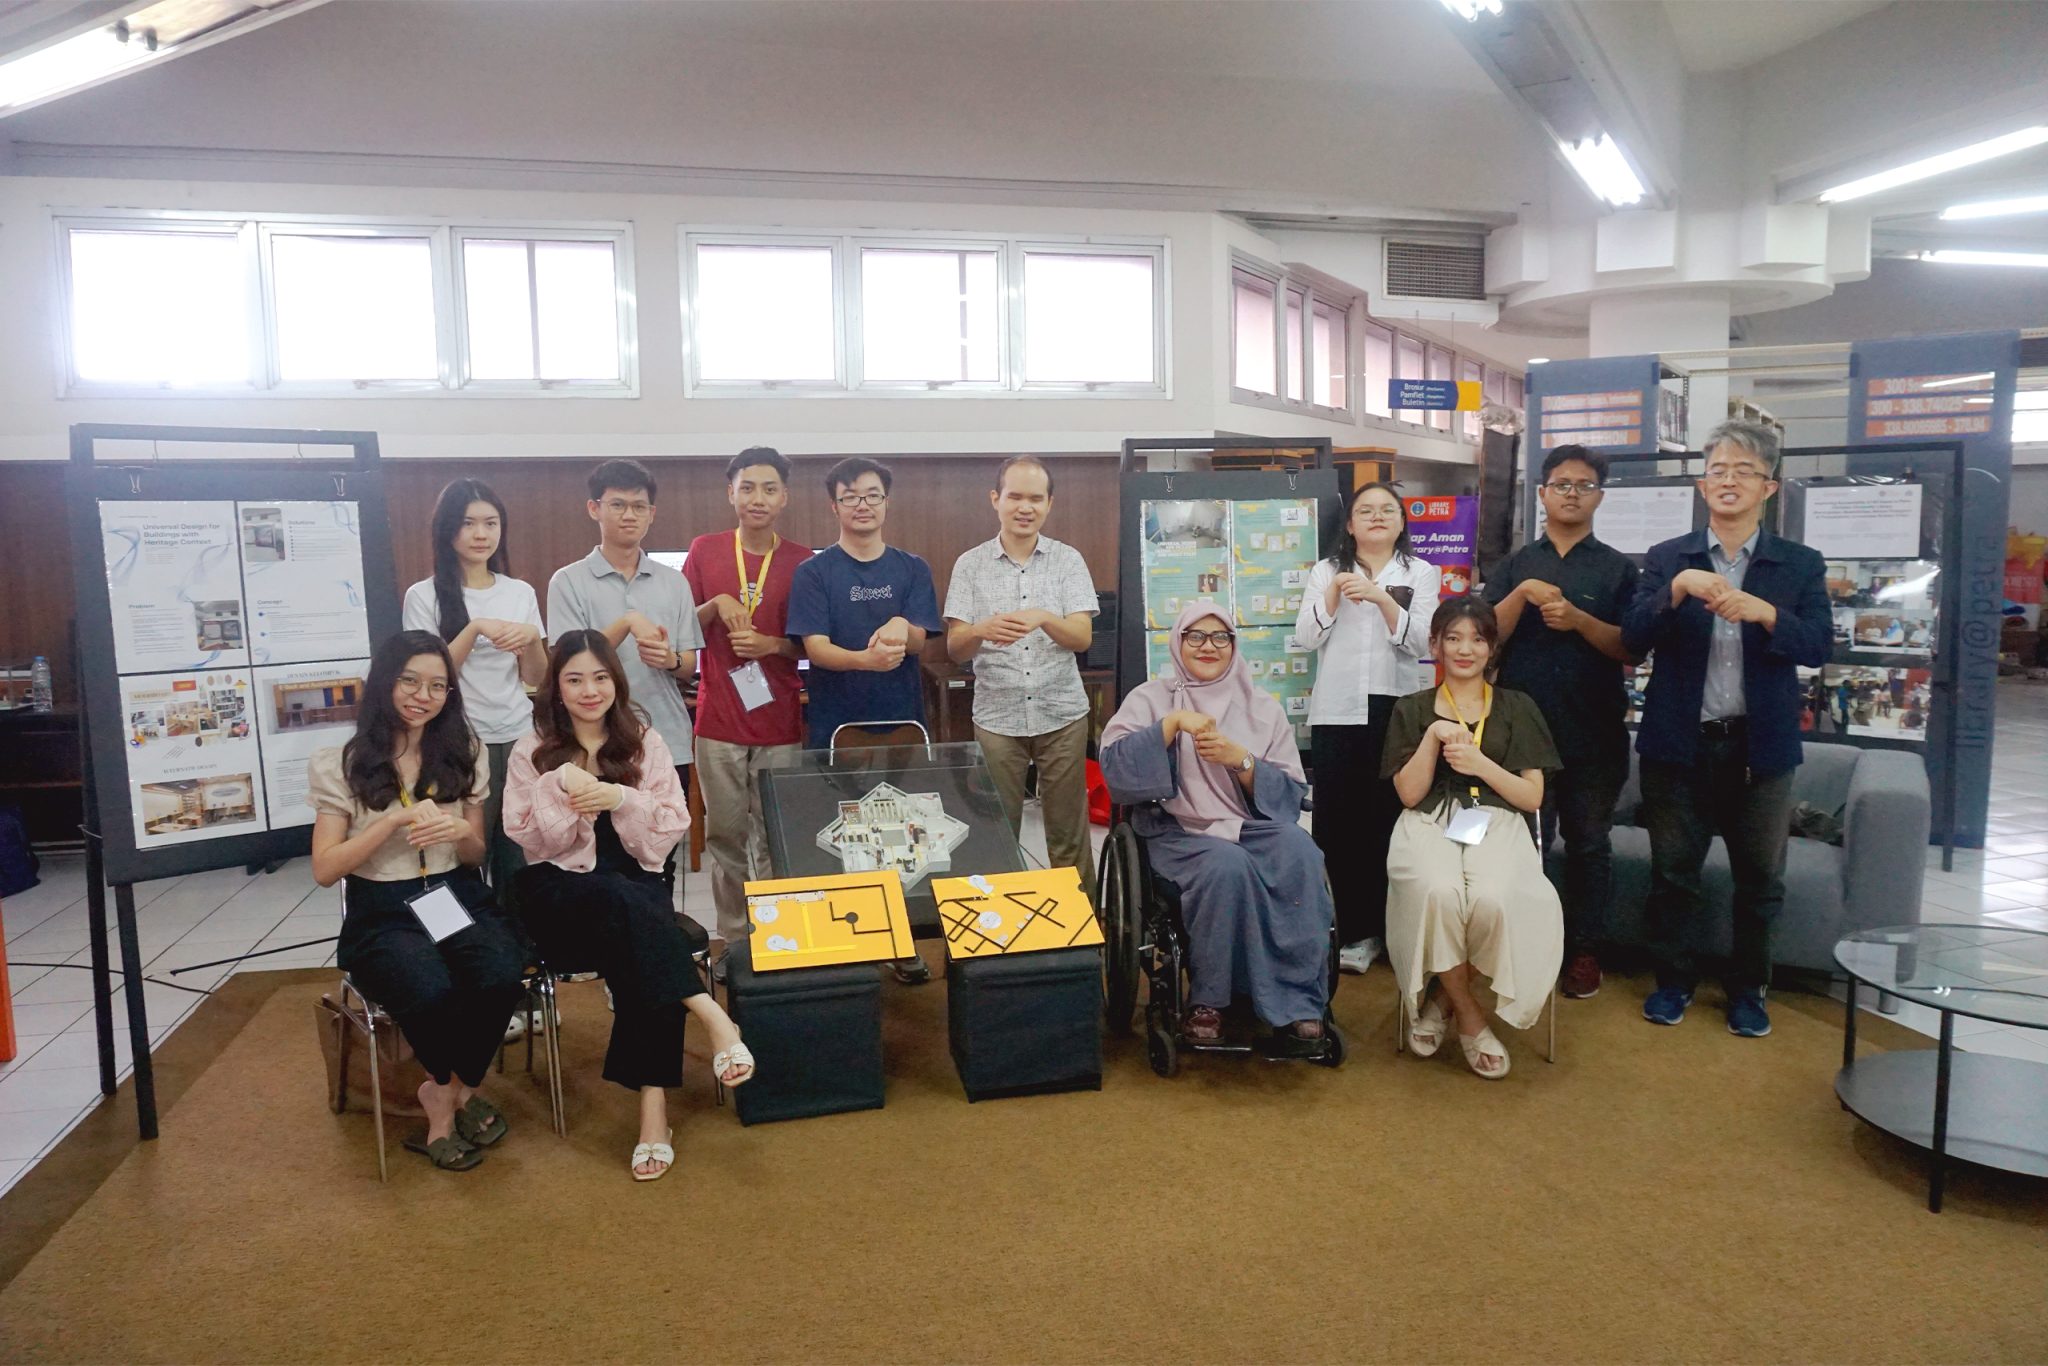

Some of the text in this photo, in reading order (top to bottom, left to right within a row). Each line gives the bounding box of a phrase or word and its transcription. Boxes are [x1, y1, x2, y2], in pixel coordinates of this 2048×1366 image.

[1404, 383, 1424, 391] Brosur
[1428, 507, 1449, 516] PETRA
[180, 523, 207, 531] Design
[143, 531, 180, 539] Buildings
[1428, 532, 1465, 542] Aman
[144, 539, 179, 547] Heritage
[850, 585, 892, 601] Street
